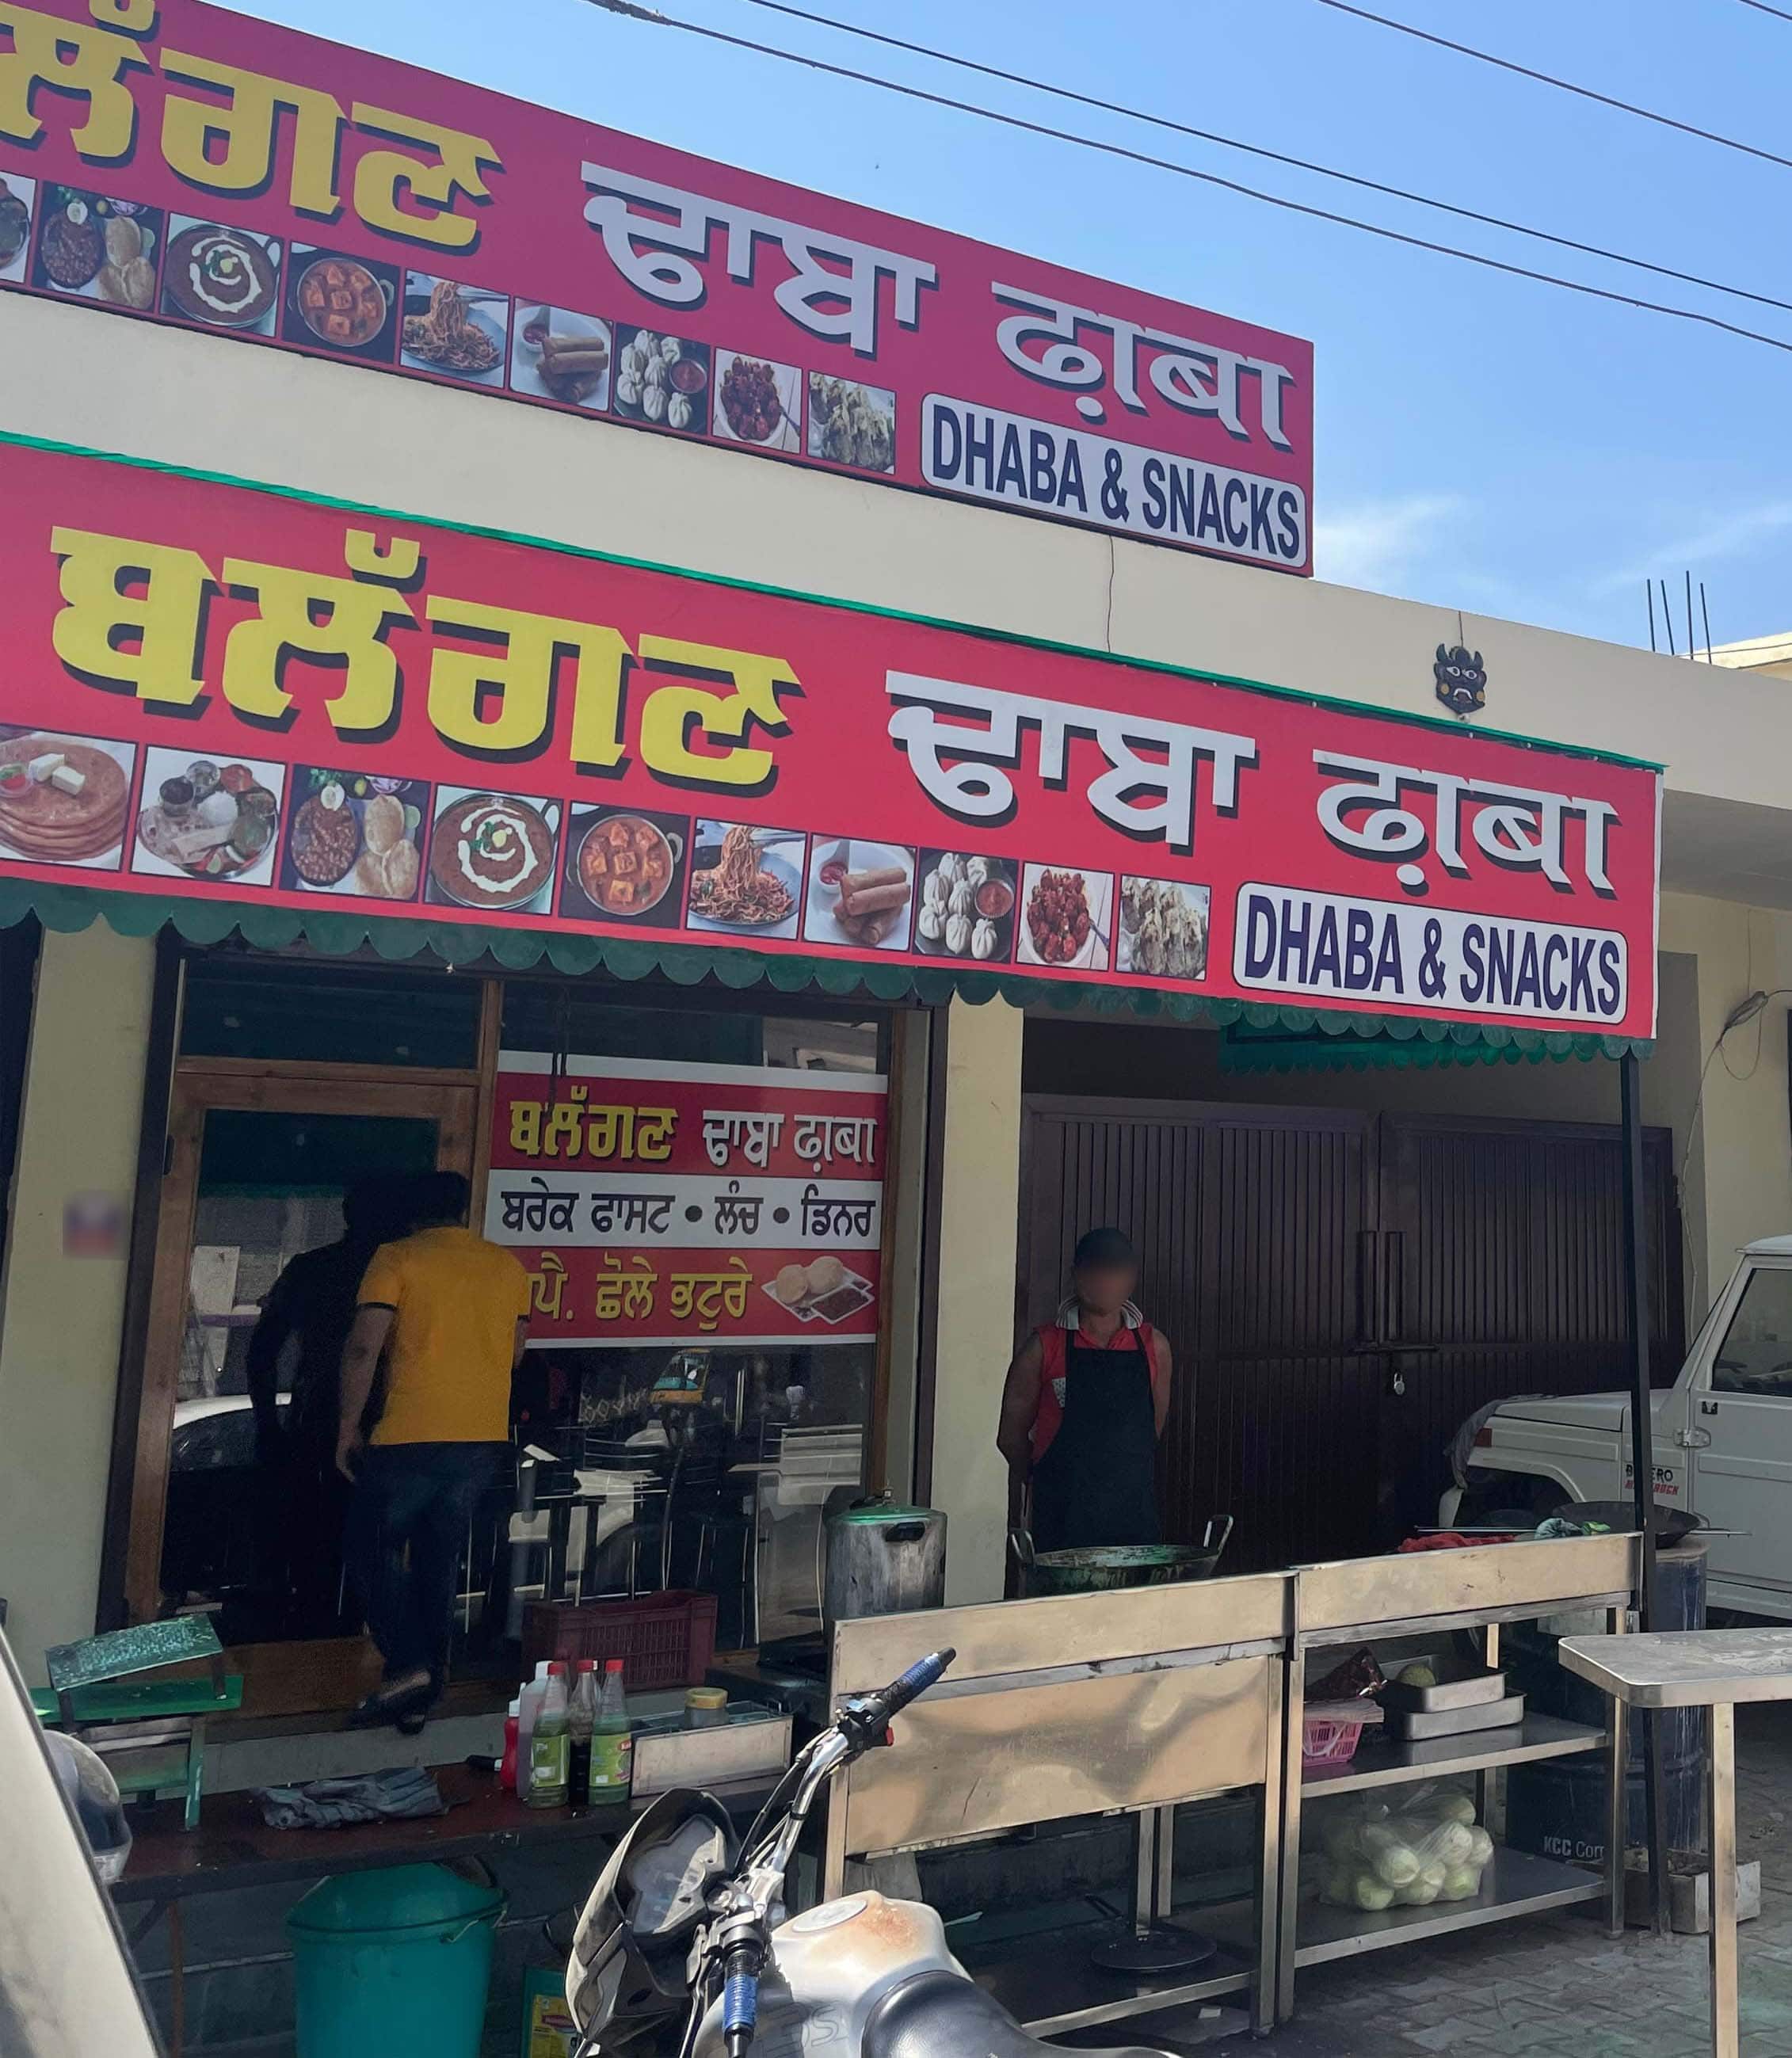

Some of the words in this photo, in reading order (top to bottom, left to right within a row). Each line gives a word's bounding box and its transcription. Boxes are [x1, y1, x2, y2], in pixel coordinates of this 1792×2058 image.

[0, 0, 502, 247] ਲੱਗਣ
[581, 160, 936, 355] ਢਾਬਾ
[991, 280, 1294, 447] ढ़ाबा
[932, 403, 1089, 513] DHABA
[1100, 447, 1130, 523] &
[1142, 457, 1301, 559] SNACKS
[50, 524, 803, 786] ਬਲੱਗਣ
[885, 669, 1256, 846] ਢਾਬਾ
[1312, 749, 1621, 892] ढ़ाबा
[1244, 894, 1405, 995] DHABA
[1418, 917, 1447, 1000] &
[1460, 923, 1620, 1016] SNACKS
[509, 1085, 679, 1160] ਬਲੱਗਣ
[703, 1109, 785, 1168] ਢਾਬਾ
[794, 1115, 879, 1173] ढ़ाबा
[501, 1176, 580, 1233] ਬਰੇਕ
[591, 1193, 676, 1234] ਫਾਸਟ
[715, 1180, 764, 1236] ਲੰਚ
[801, 1183, 876, 1237] ਡਿਨਰ
[596, 1249, 658, 1320] ਛੋਲੇ
[1544, 1836, 1572, 1857] KCC
